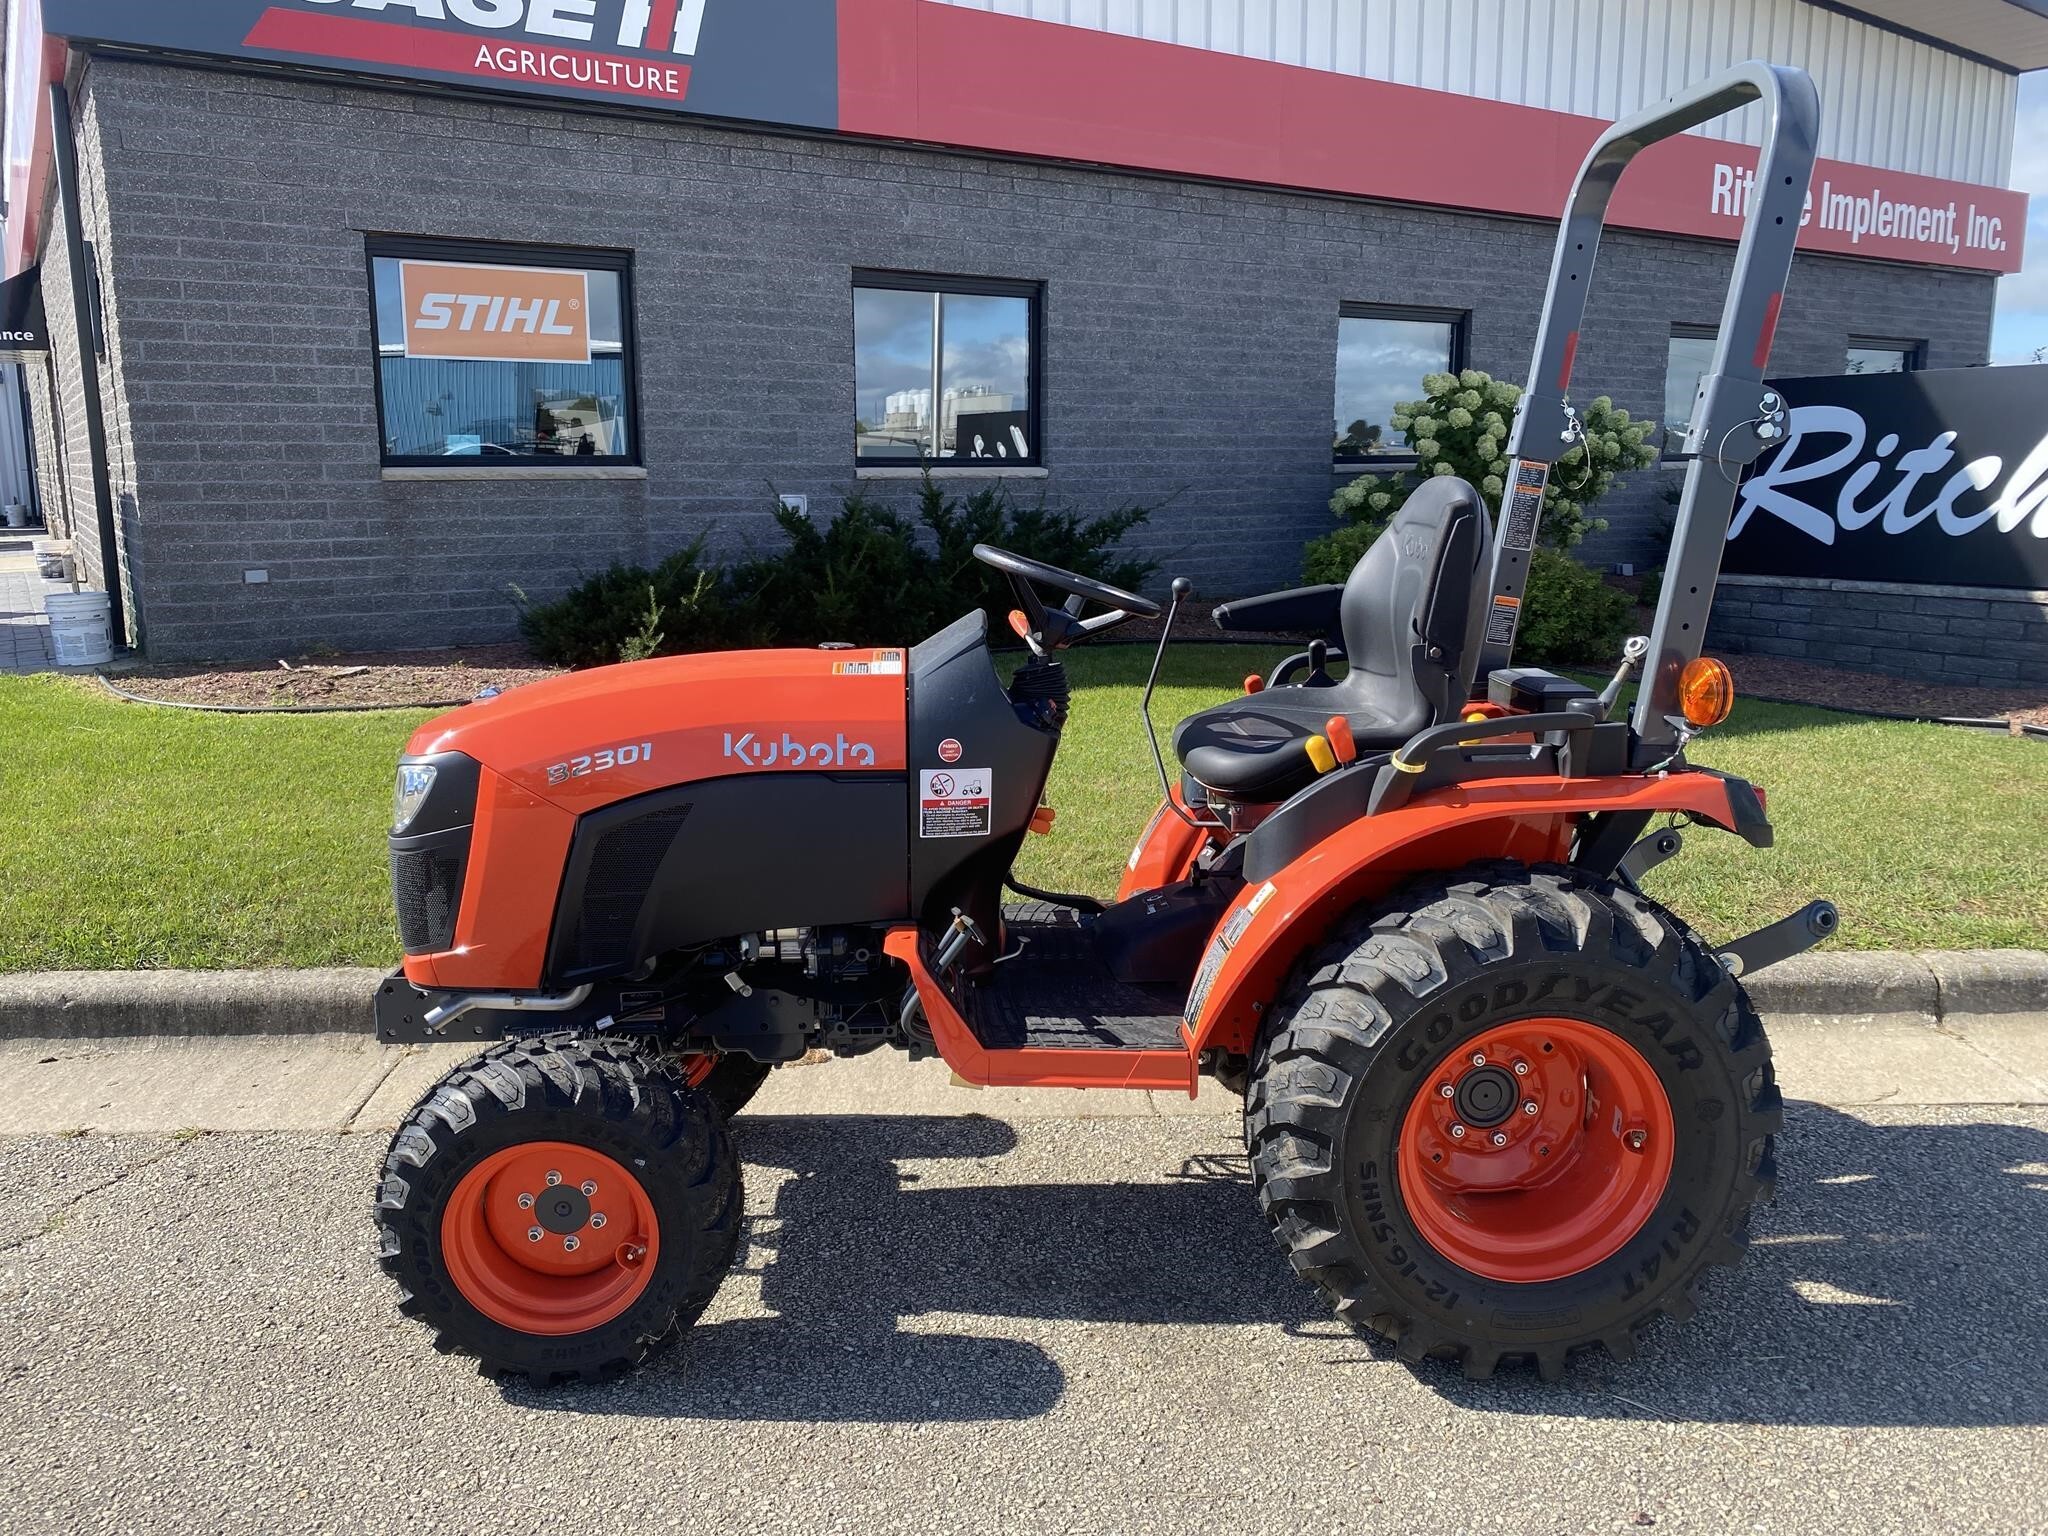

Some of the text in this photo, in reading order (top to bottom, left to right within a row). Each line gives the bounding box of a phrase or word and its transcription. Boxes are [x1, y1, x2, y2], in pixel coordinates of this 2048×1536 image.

[474, 44, 680, 95] AGRICULTURE
[1711, 163, 2007, 255] Rite Implement, Inc.
[0, 330, 34, 341] nce
[414, 292, 574, 336] STIHL
[546, 742, 652, 786] B2301
[723, 732, 876, 766] Kubota
[1399, 973, 1703, 1072] GOODYEAR
[1621, 1207, 1701, 1302] R14T
